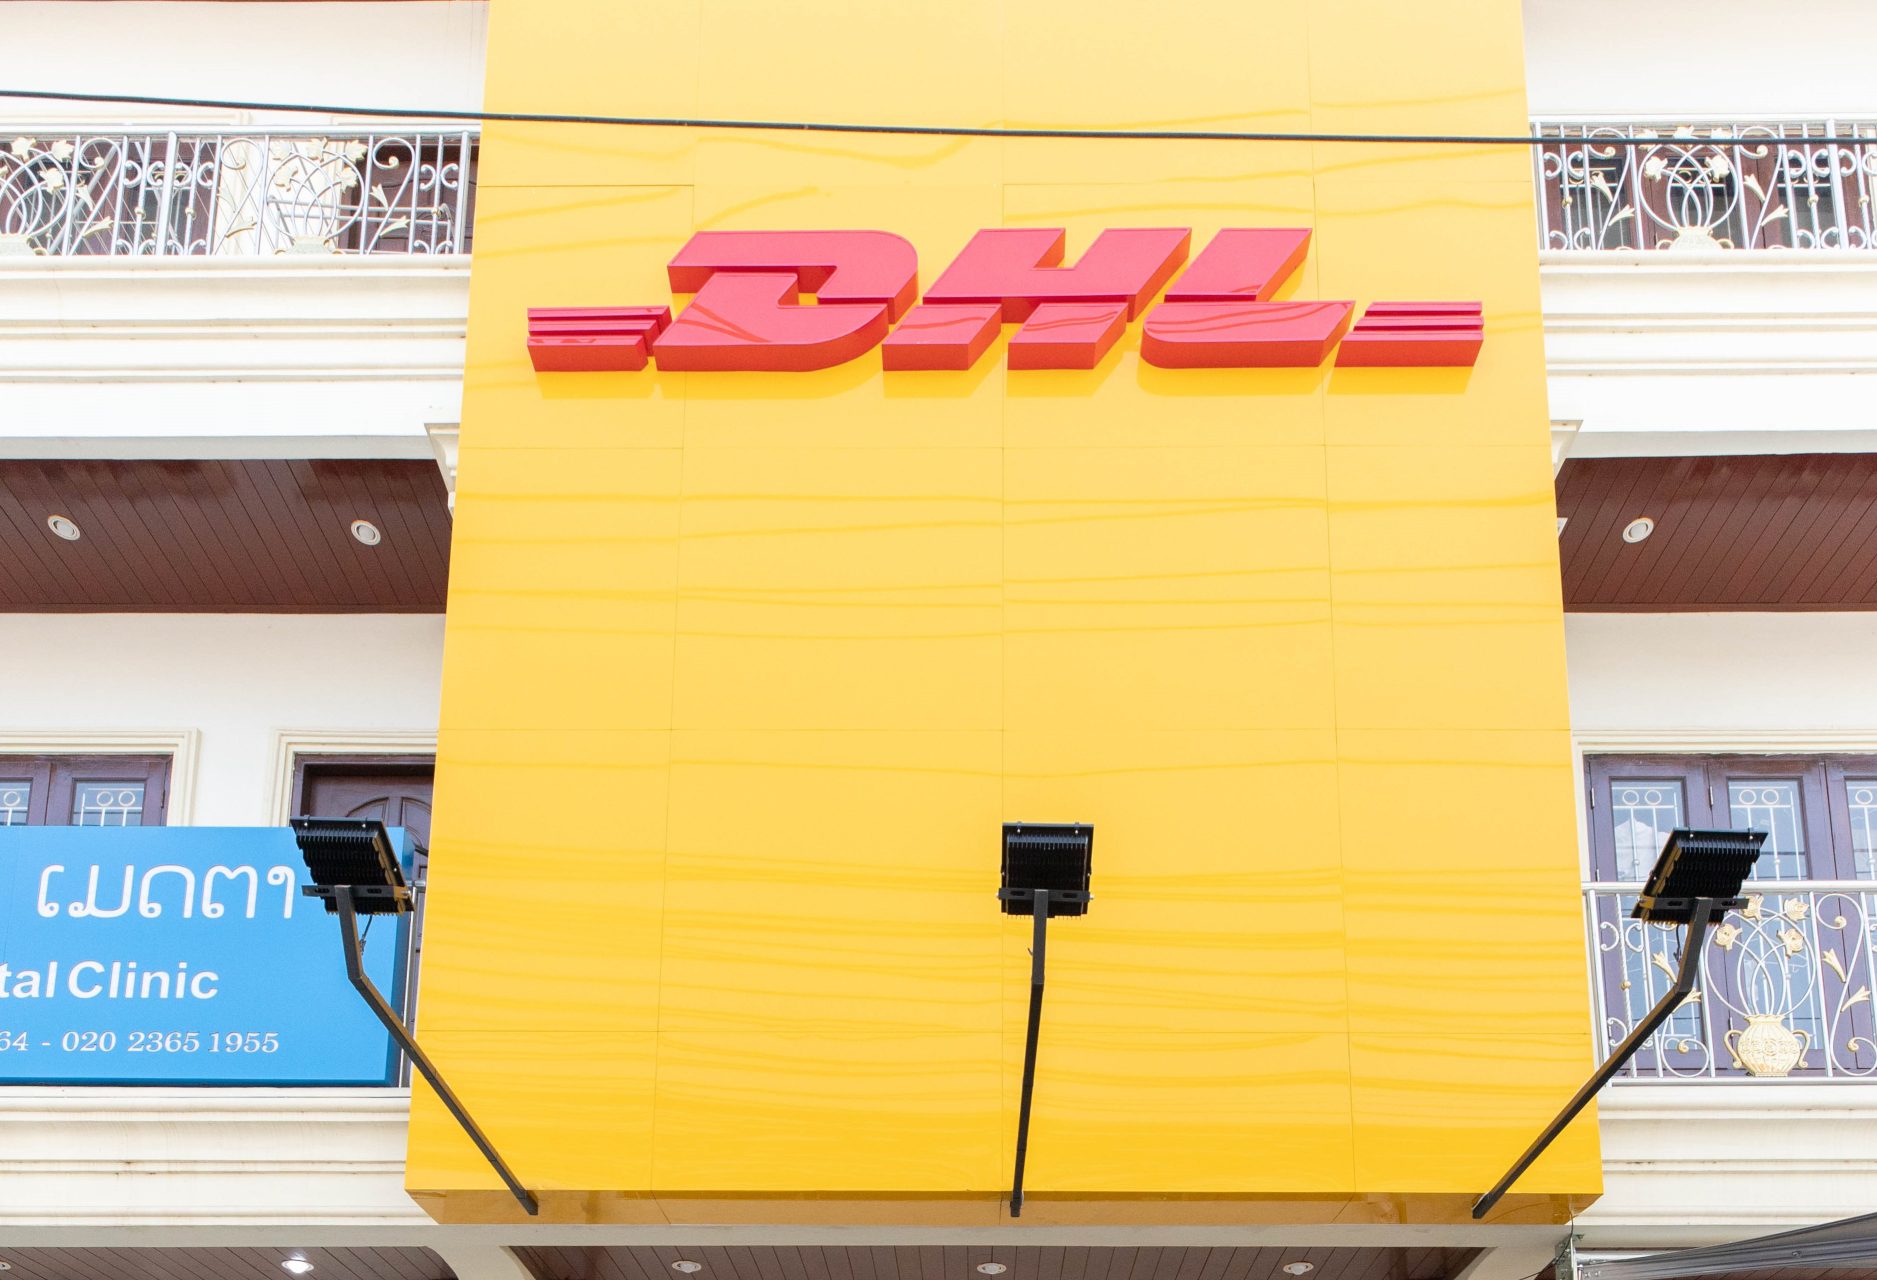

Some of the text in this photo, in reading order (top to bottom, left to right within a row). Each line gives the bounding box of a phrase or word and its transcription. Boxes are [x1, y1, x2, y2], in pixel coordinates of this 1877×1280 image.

[654, 228, 1357, 371] DHL
[0, 960, 219, 999] tal Clinic
[62, 1031, 117, 1052] 020
[127, 1031, 200, 1053] 2365
[208, 1032, 279, 1053] 1955
